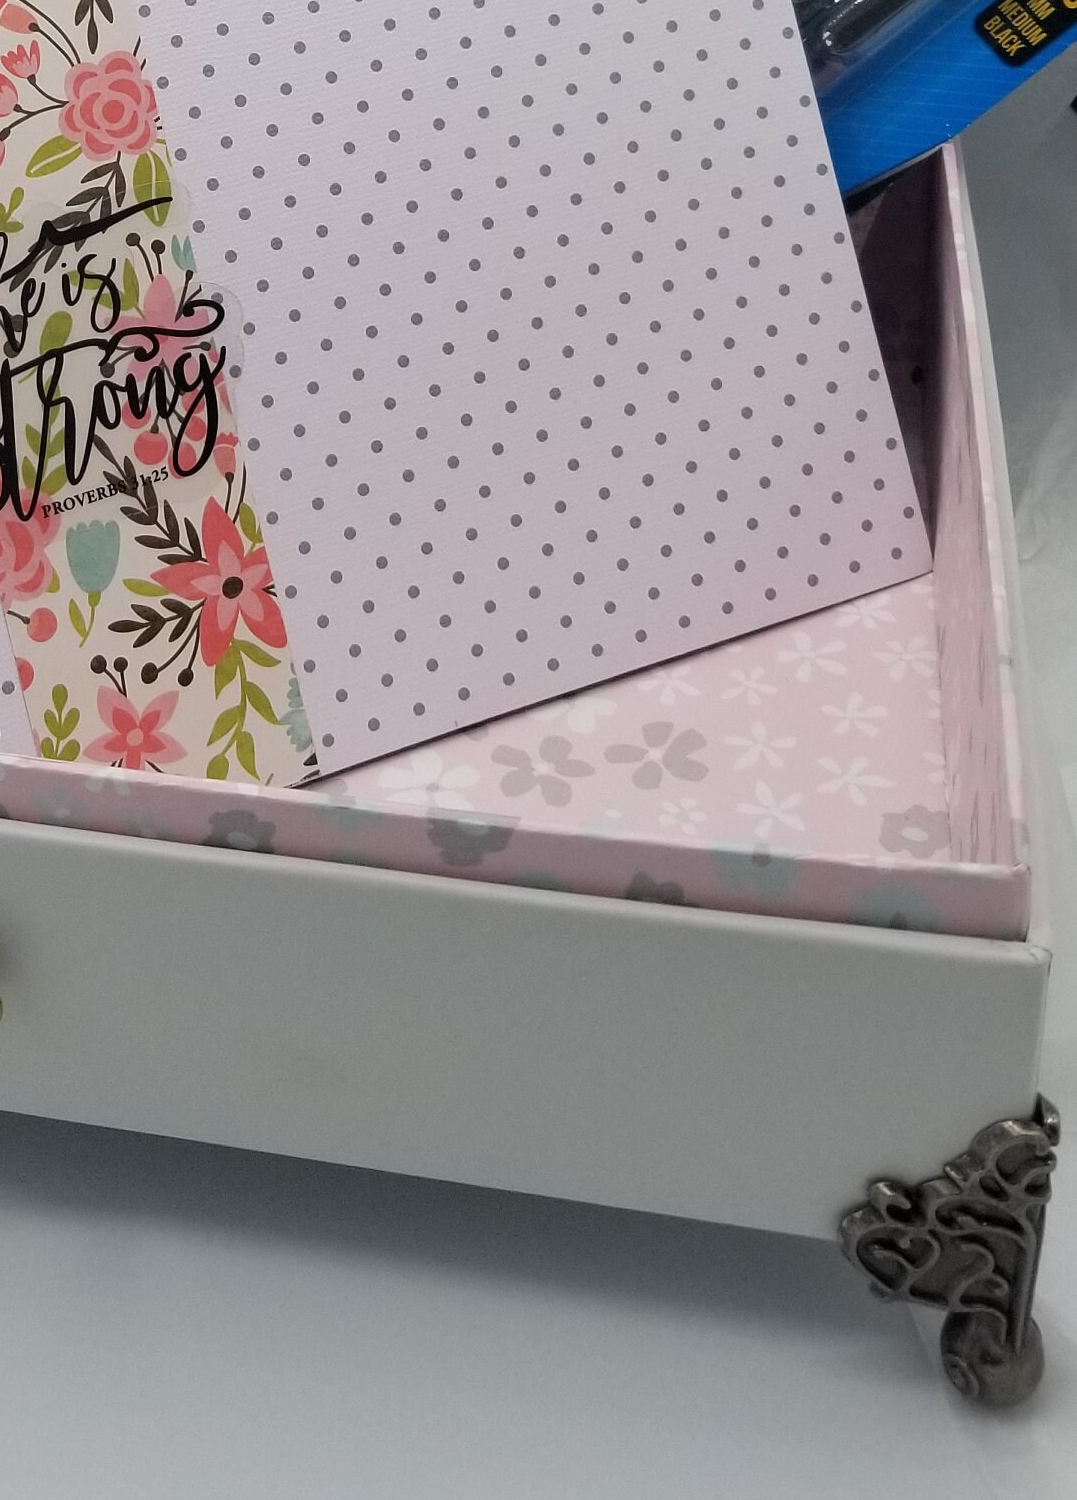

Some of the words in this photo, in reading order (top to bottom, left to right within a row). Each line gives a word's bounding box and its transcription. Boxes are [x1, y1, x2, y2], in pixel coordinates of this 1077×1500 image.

[983, 15, 1026, 57] BLACK
[60, 253, 122, 333] is
[41, 480, 127, 519] PROVERBS
